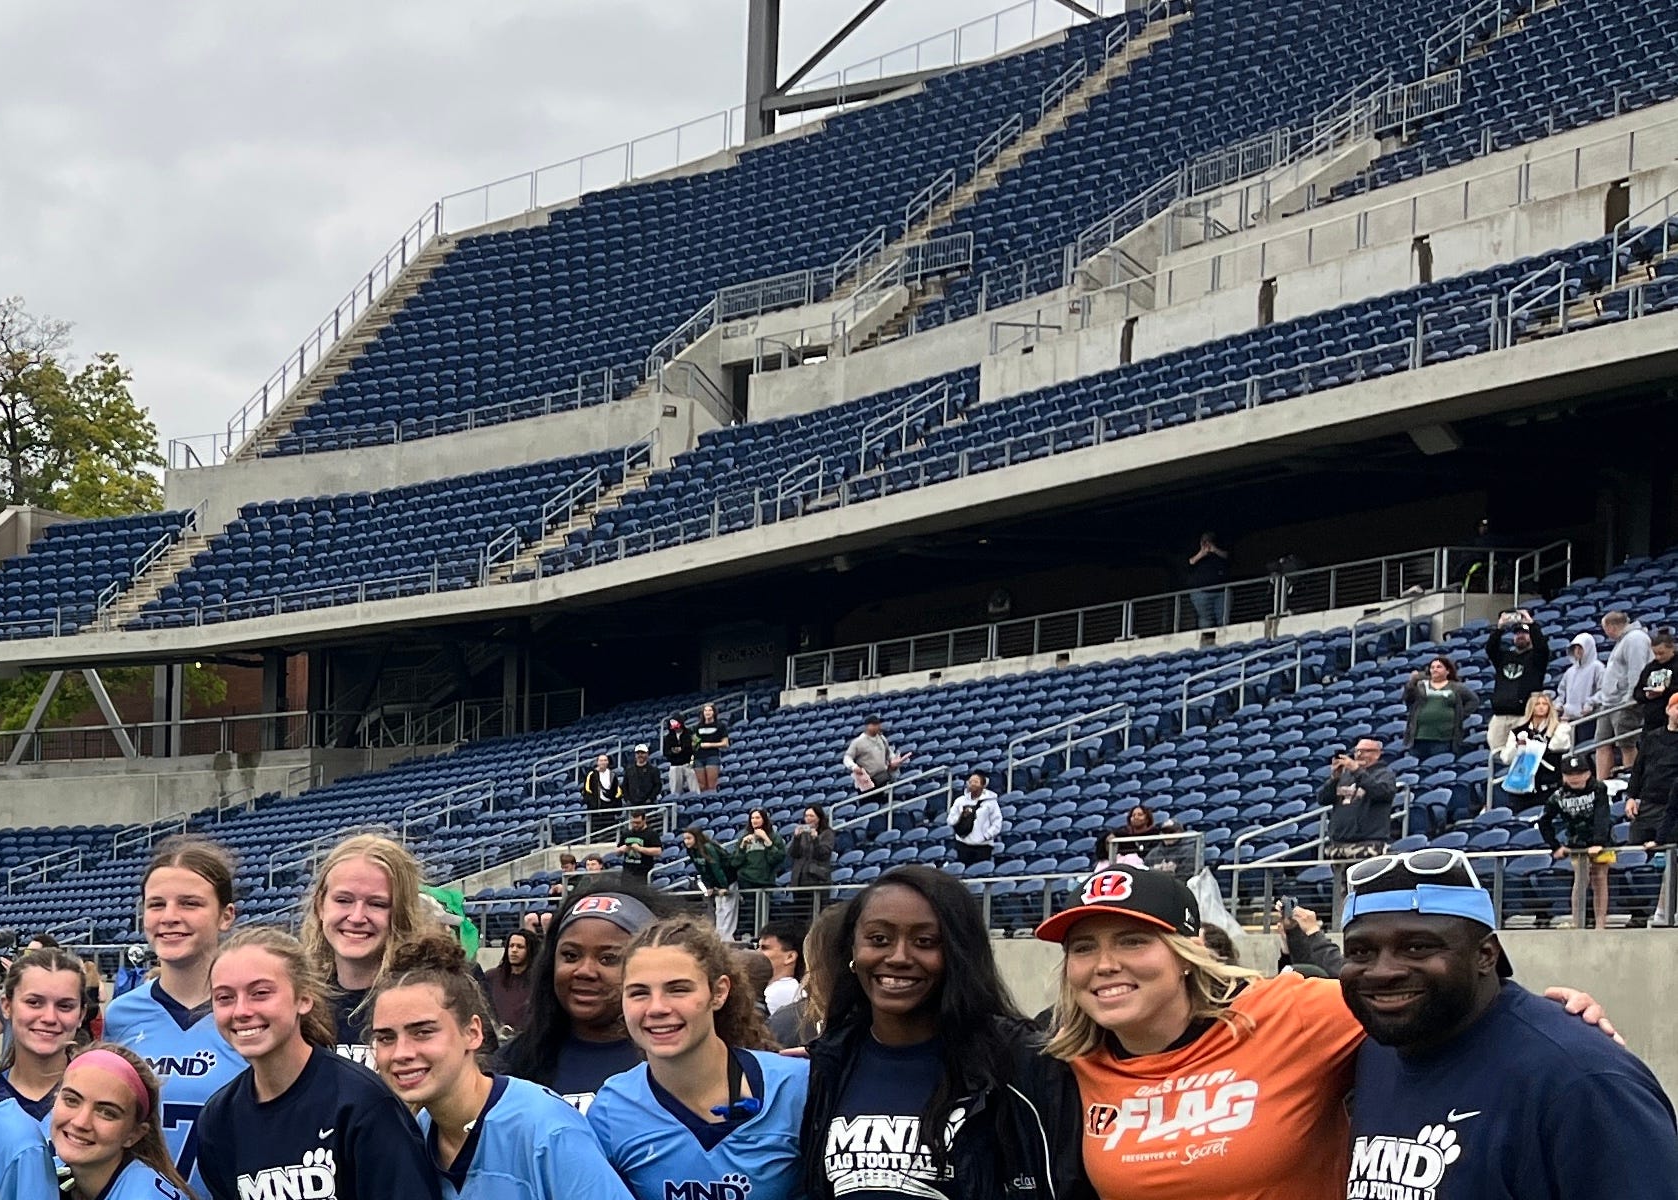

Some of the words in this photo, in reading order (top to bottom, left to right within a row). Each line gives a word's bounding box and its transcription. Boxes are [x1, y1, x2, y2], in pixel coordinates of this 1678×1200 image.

[162, 1103, 205, 1183] 7
[1102, 1080, 1259, 1151] FLAG
[856, 1152, 938, 1173] FOOTBAL
[1180, 1136, 1233, 1165] Secret
[1348, 1135, 1446, 1190] MND
